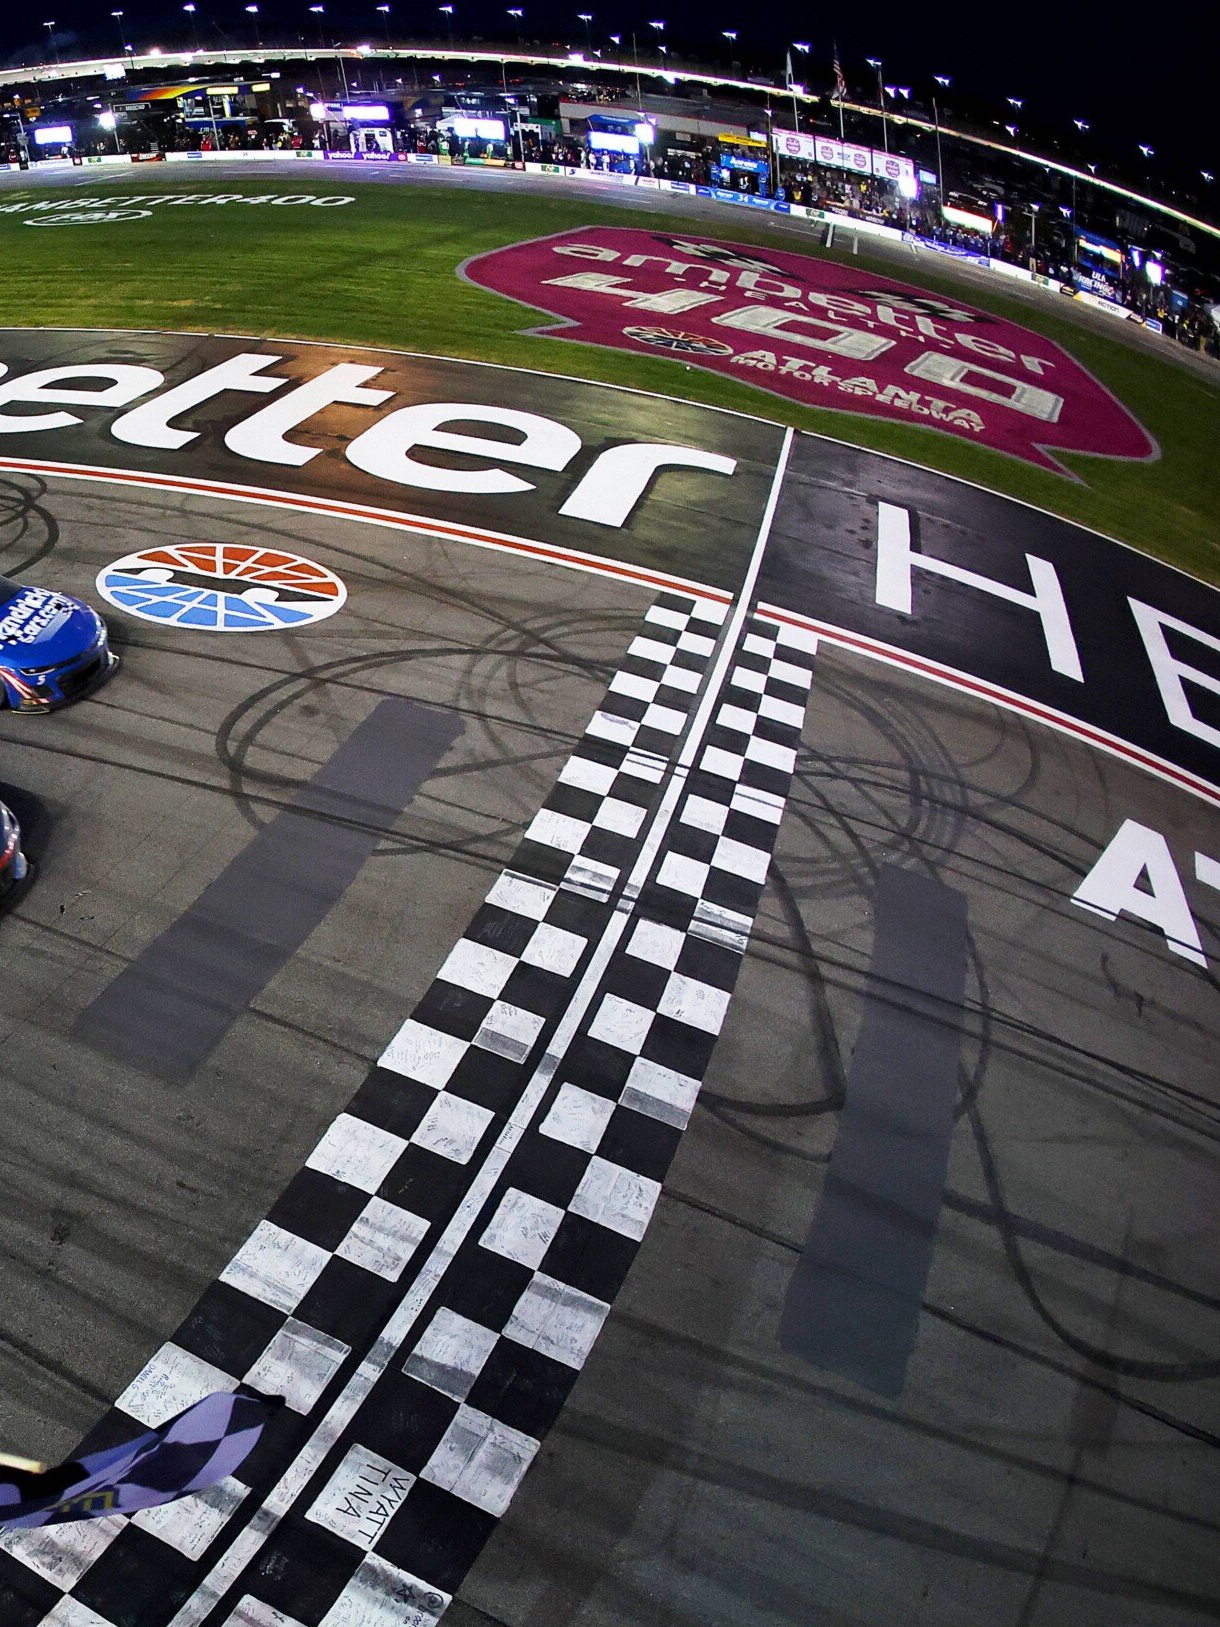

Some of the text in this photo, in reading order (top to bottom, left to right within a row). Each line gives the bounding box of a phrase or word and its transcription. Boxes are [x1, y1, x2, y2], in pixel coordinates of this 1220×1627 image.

[327, 151, 390, 160] yahoo! yahoo!
[552, 243, 1056, 376] ambetter
[541, 271, 1065, 424] 400
[747, 349, 986, 428] ATLANTA
[36, 675, 46, 686] 5
[335, 1464, 392, 1519] TINA
[358, 1476, 410, 1545] WYATT
